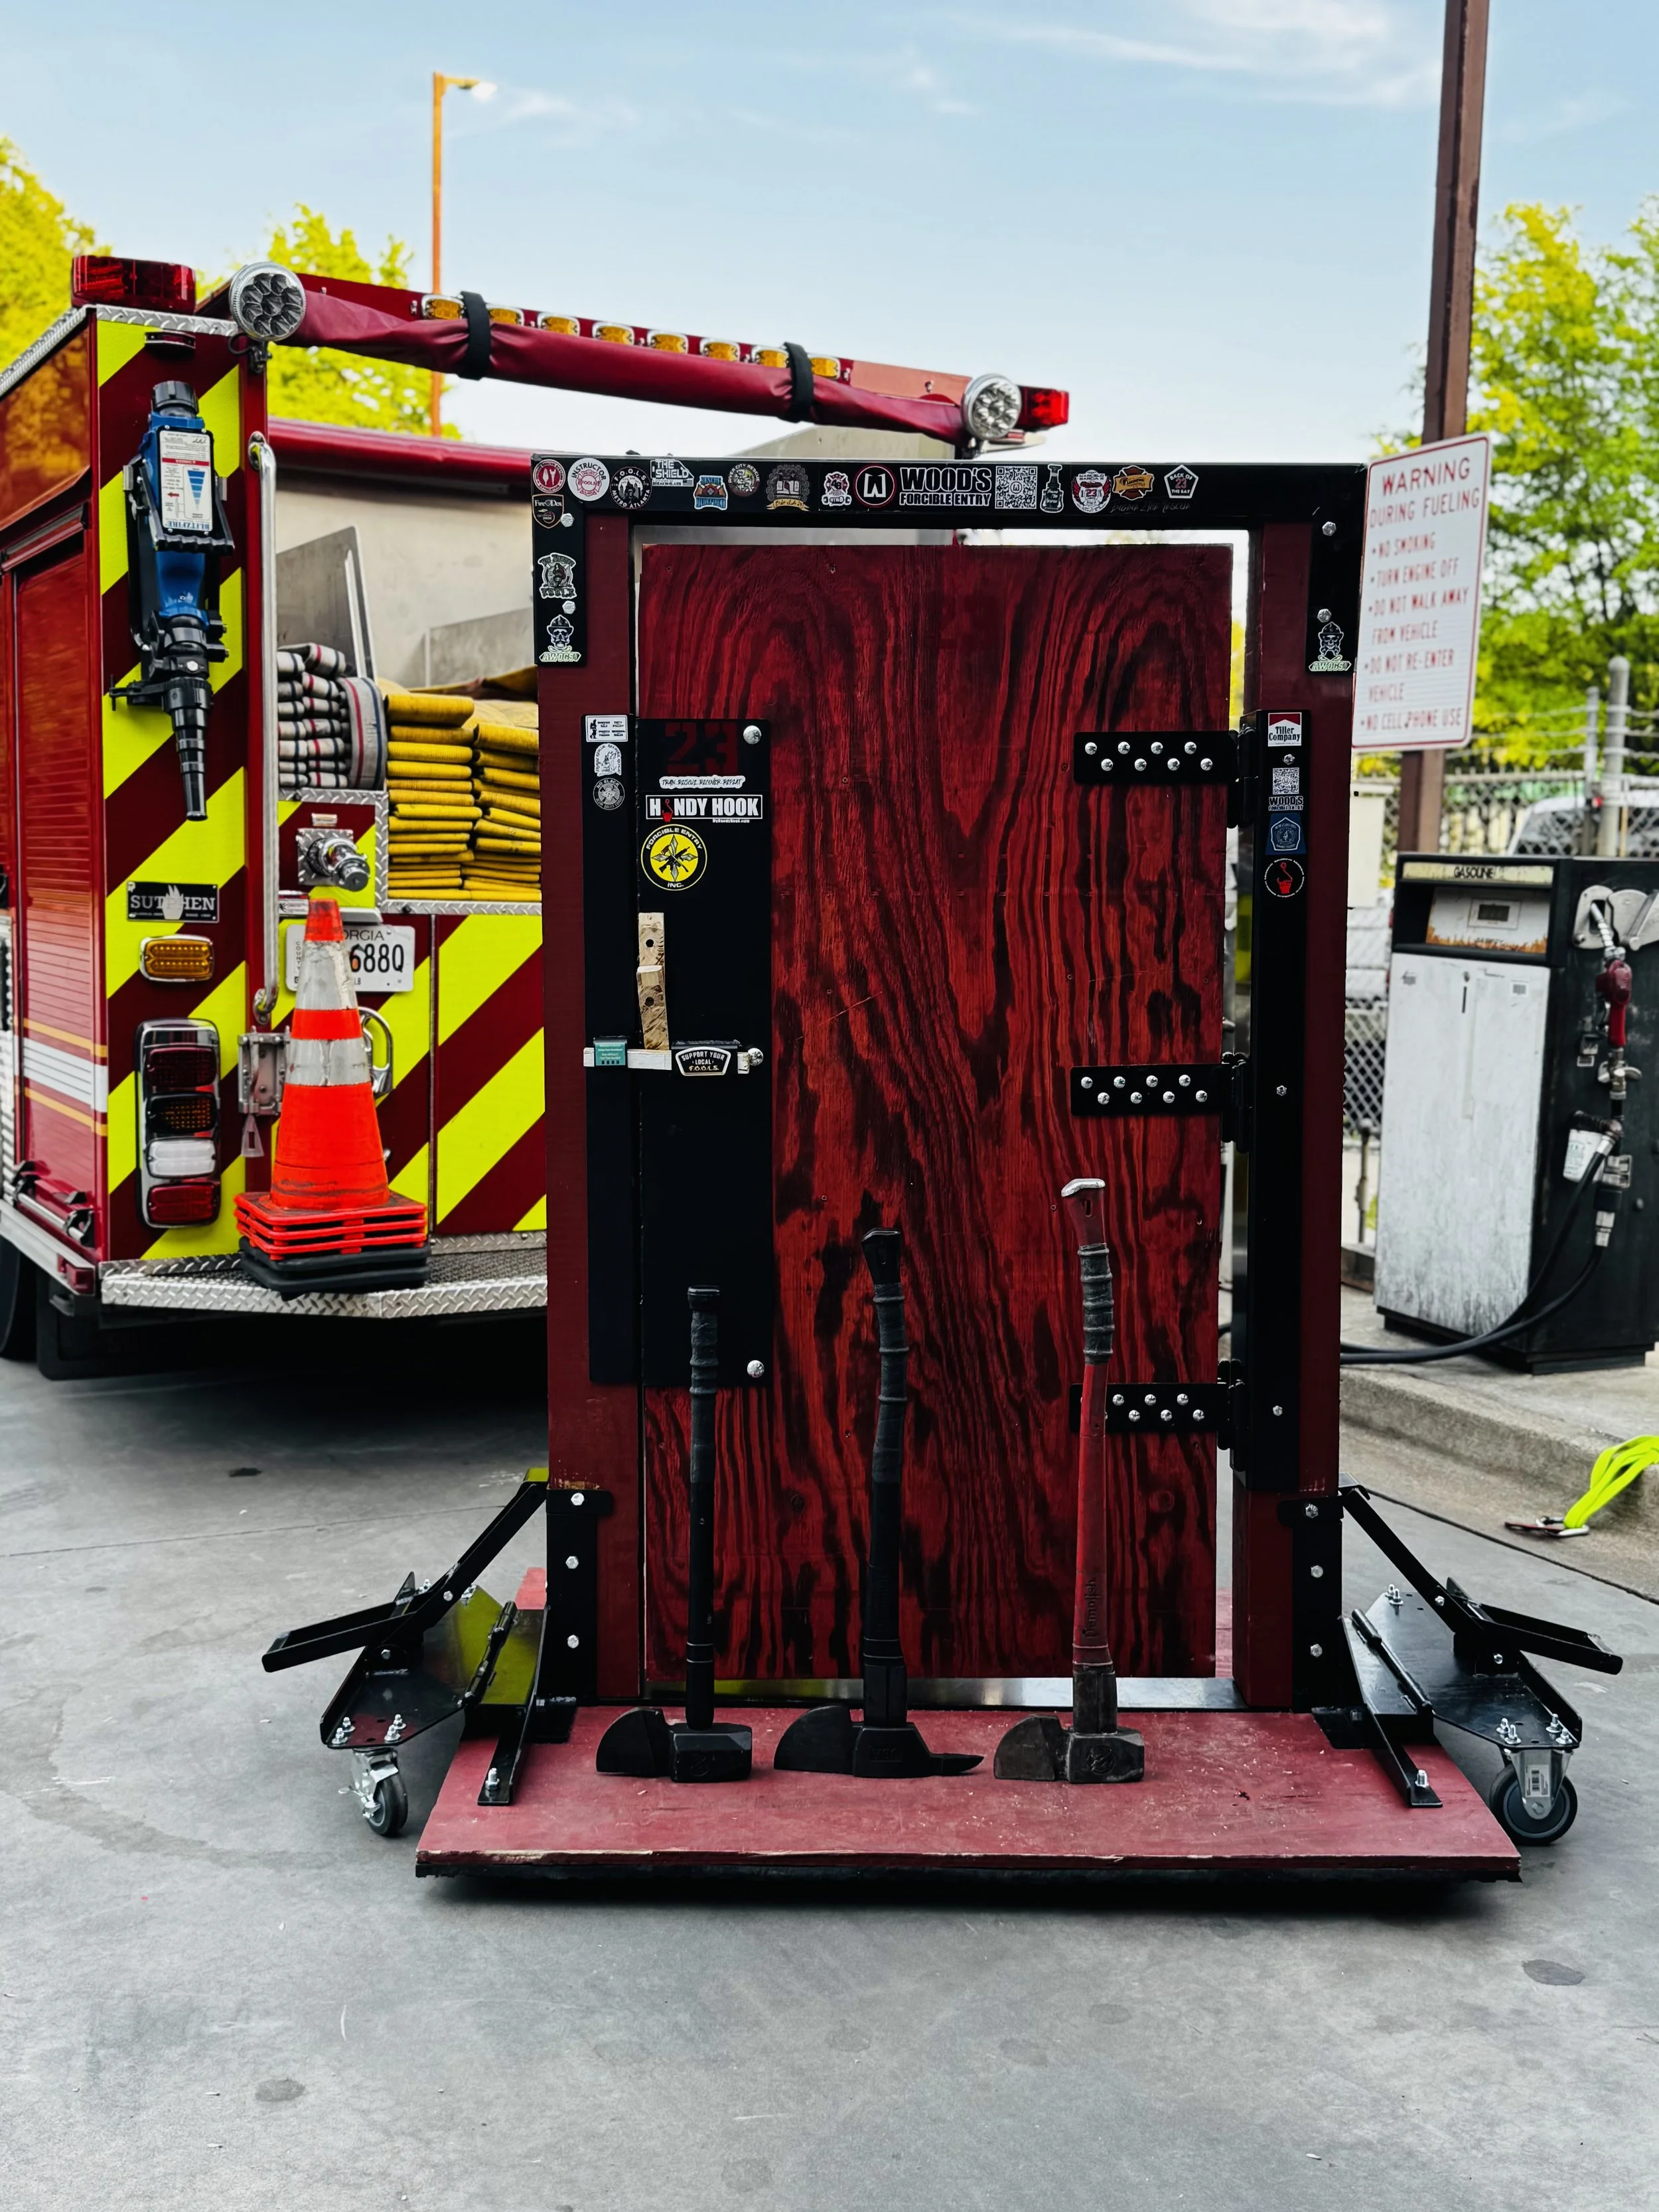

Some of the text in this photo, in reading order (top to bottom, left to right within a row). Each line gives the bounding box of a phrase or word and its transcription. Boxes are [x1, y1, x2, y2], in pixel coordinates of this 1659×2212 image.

[571, 462, 607, 480] INSTRUCTOR
[655, 459, 674, 469] THE
[747, 464, 760, 482] RESCUE
[656, 469, 689, 479] SHIELD
[900, 467, 992, 492] WOOD'S
[1175, 478, 1187, 489] 23
[1382, 457, 1471, 496] WARNING
[612, 489, 650, 508] METRO ATLANTA
[899, 492, 992, 506] FORCIBLE ENTRY
[1370, 486, 1480, 528] DURING FUELING
[1378, 531, 1436, 559] NO SMOKING
[1377, 557, 1459, 588] TURN ENGINE OFF
[1374, 586, 1469, 617] DO NOT WALK AWAY
[1372, 620, 1439, 645] FROM VEHICLE
[1370, 648, 1454, 674] DO NOT RE-ENTER
[1368, 682, 1405, 703] VEHICLE
[1366, 707, 1463, 731] NO CELL PHONE USE
[1268, 732, 1301, 742] Company
[1275, 726, 1295, 735] Tiller
[665, 721, 738, 775] 23
[712, 797, 759, 816] HOOK
[1268, 796, 1304, 806] WOOD'S
[646, 827, 703, 850] FORCIBLE ENTRY
[343, 929, 385, 941] ORGIA
[681, 1051, 725, 1061] SUPPORT YOUR
